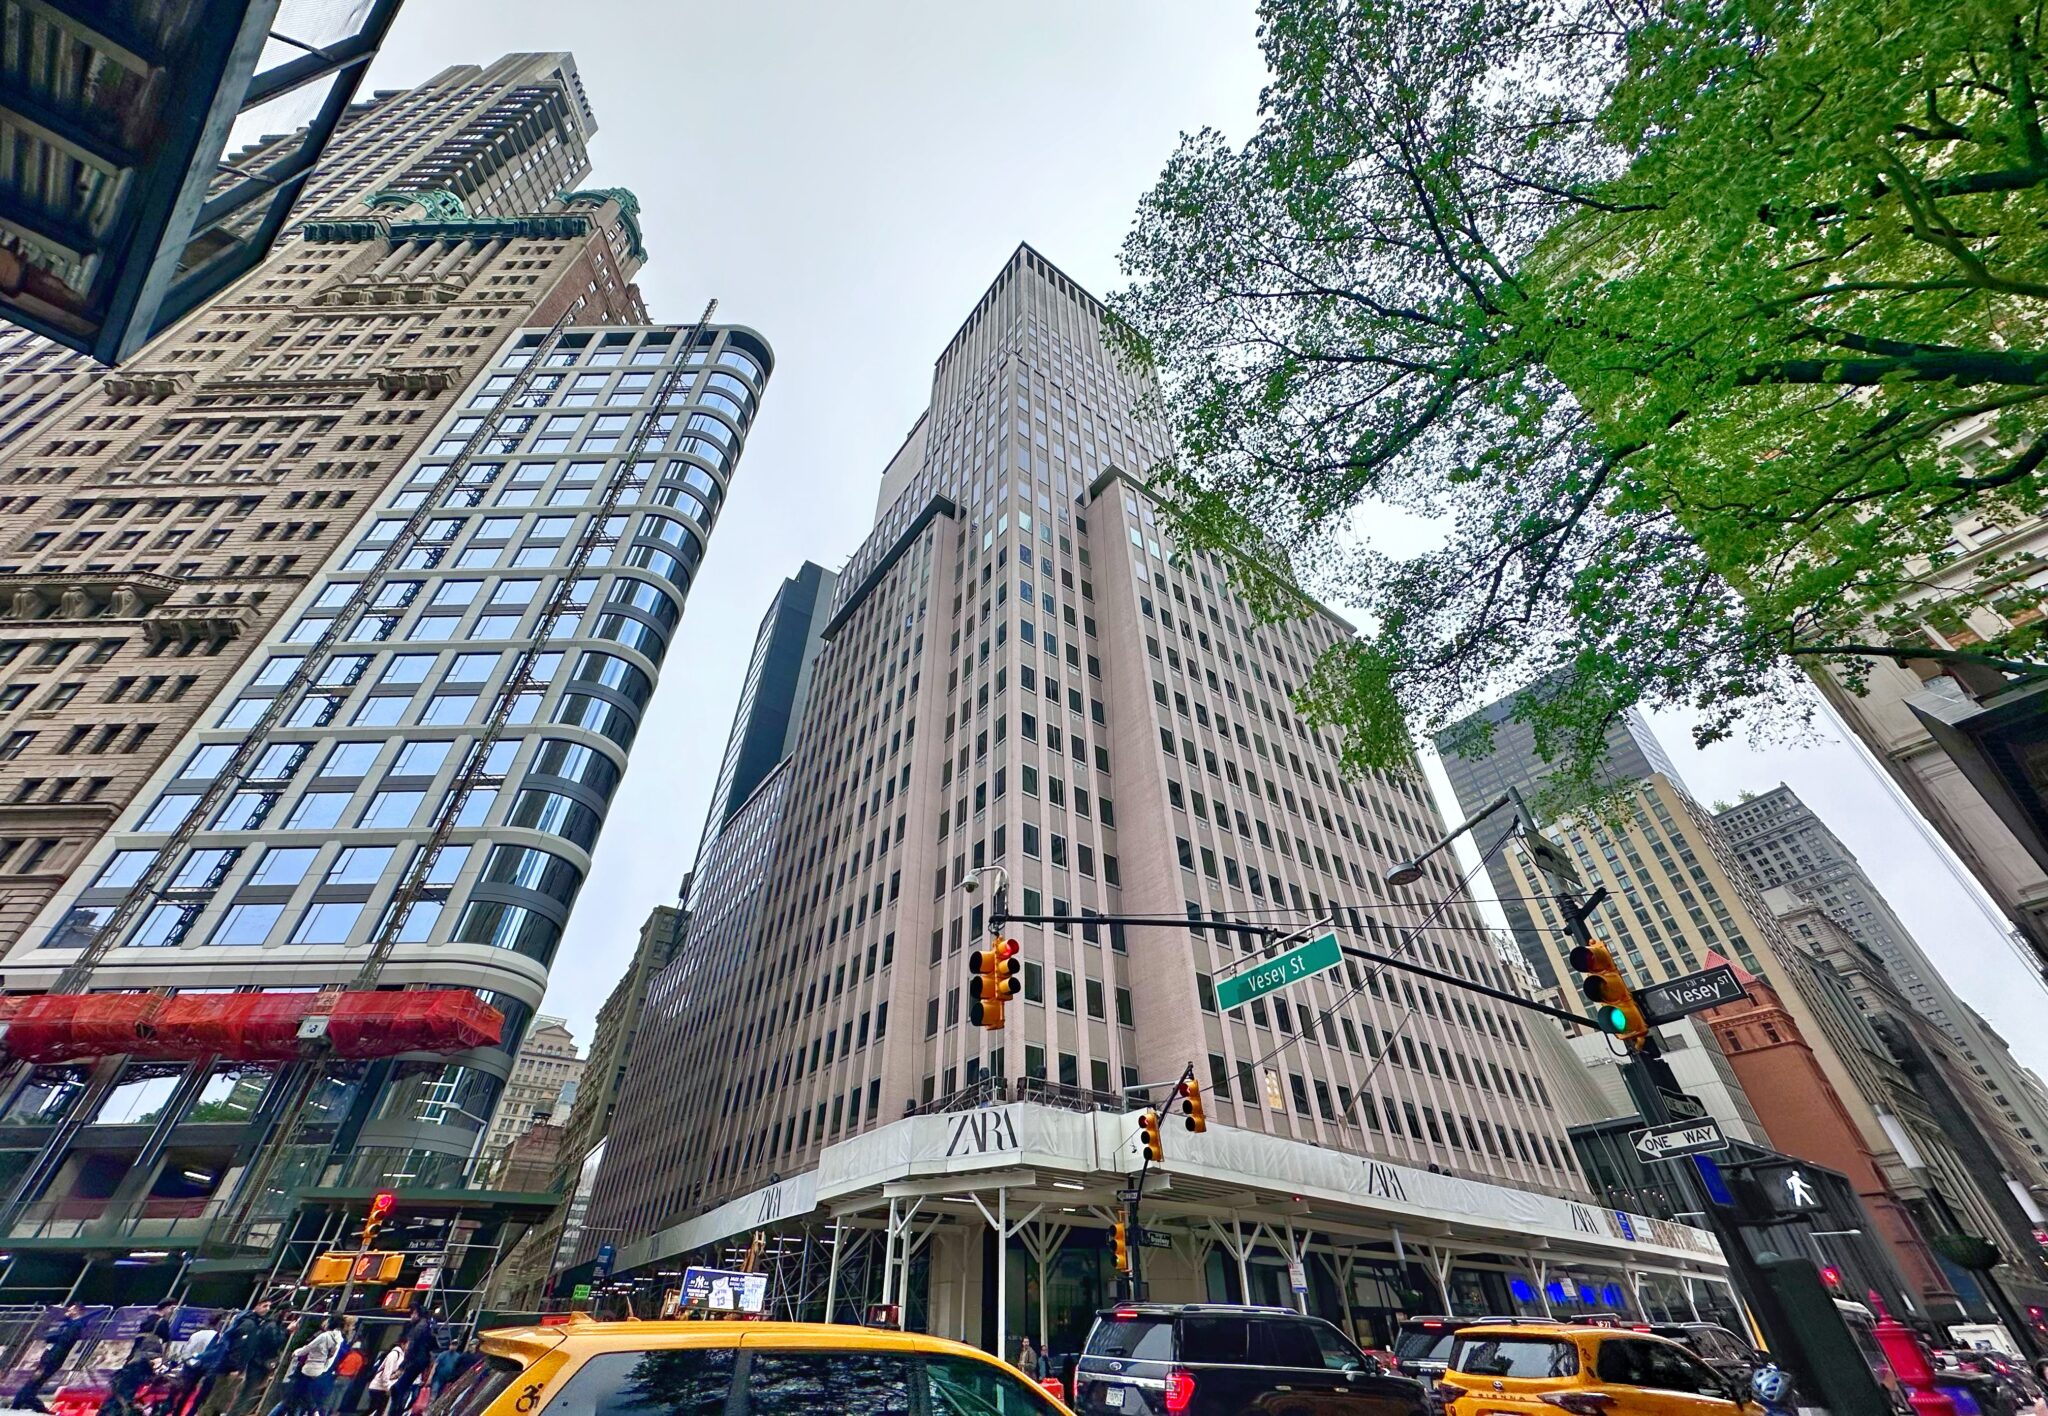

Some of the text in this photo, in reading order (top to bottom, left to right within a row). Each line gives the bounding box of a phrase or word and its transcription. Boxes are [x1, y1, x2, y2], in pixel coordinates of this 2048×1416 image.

[1247, 955, 1306, 992] Vesey St
[1669, 975, 1729, 1005] Vesey ST
[946, 1108, 1020, 1157] ZARA
[1644, 1127, 1713, 1151] ONE WAY
[1362, 1160, 1407, 1202] ZARA
[757, 1186, 782, 1223] ZARA
[1565, 1202, 1600, 1235] ZARA
